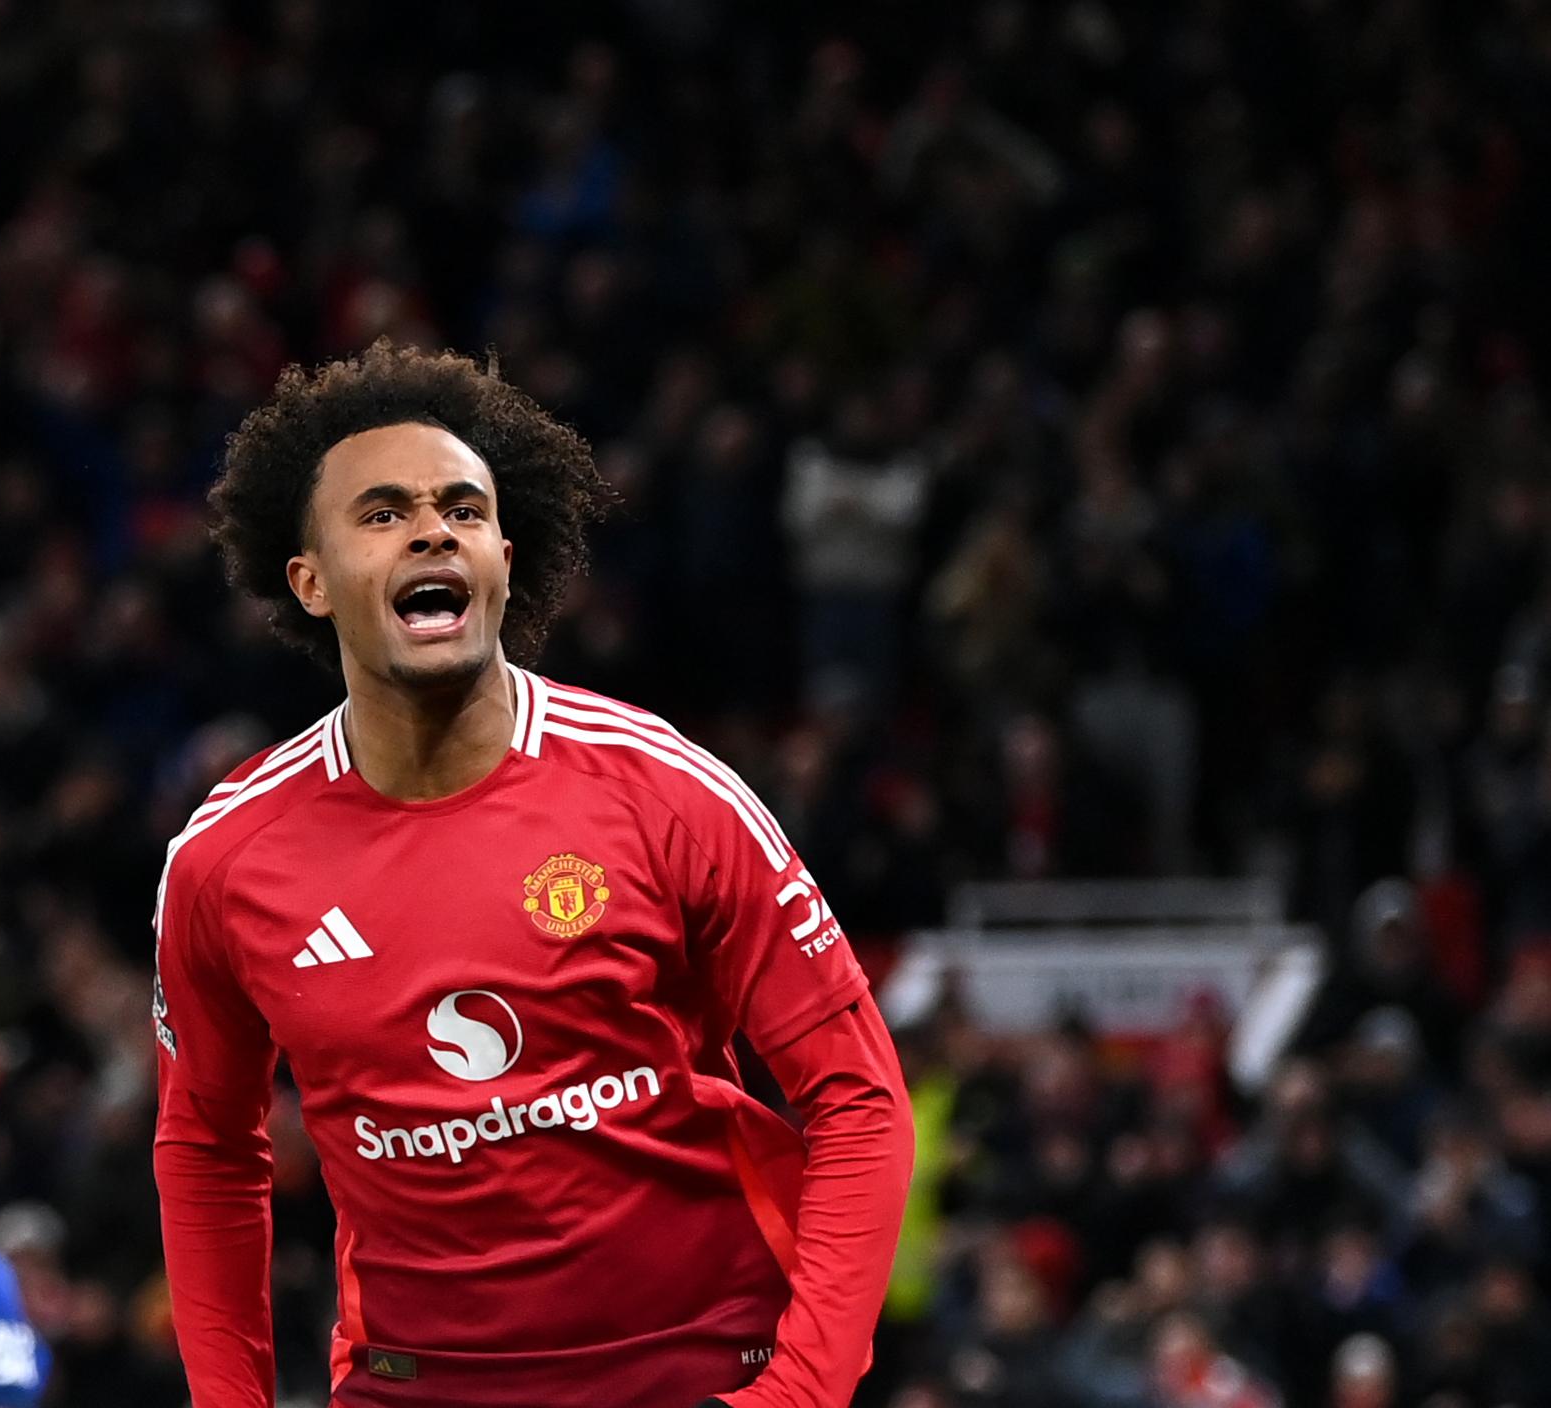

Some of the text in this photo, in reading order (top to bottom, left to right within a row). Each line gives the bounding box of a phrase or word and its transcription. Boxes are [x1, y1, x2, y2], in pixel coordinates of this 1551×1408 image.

[529, 860, 599, 891] MANCHESTER
[546, 914, 594, 932] UNITED
[355, 1065, 661, 1163] Snapdragon
